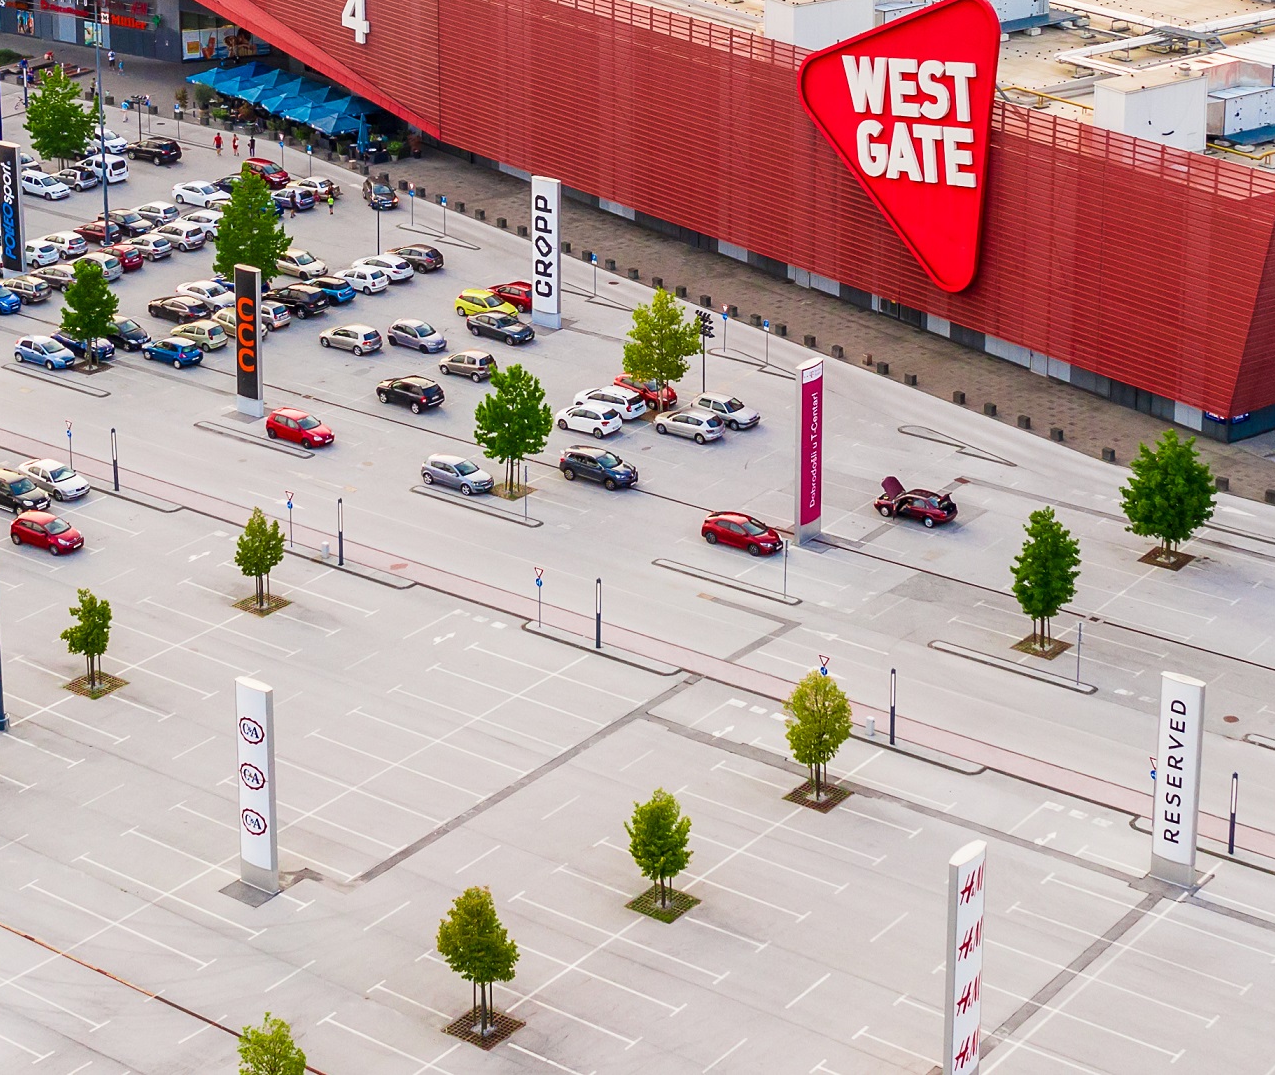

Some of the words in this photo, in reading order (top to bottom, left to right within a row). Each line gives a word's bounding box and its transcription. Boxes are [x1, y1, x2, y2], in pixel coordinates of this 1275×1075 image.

[841, 55, 977, 123] WEST
[856, 119, 977, 188] GATE
[534, 194, 553, 298] CROPP
[237, 297, 255, 373] CCC
[242, 722, 260, 740] C&A
[243, 767, 261, 785] C&A
[1163, 699, 1187, 845] RESERVED
[244, 813, 262, 830] C&A
[959, 858, 985, 906] H&M
[958, 915, 984, 962] H&M
[956, 970, 982, 1017] H&M
[954, 1024, 980, 1072] H&M
